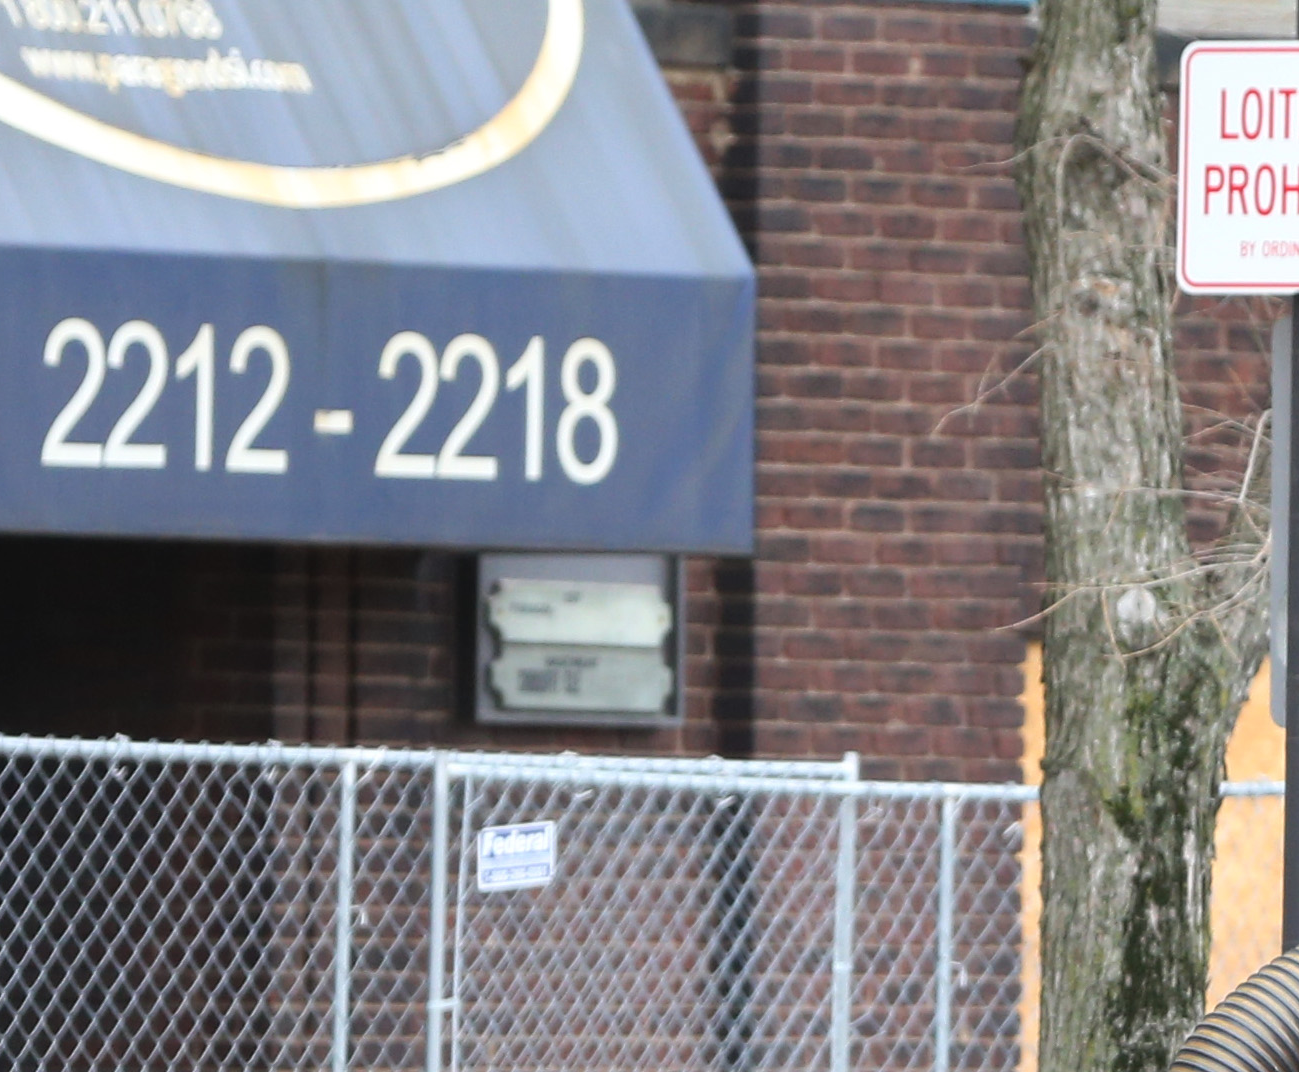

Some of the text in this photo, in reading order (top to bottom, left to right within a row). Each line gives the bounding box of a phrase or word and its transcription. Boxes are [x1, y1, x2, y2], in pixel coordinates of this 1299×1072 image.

[1240, 240, 1256, 257] BY
[41, 317, 291, 474] 2212
[374, 331, 619, 485] 2218
